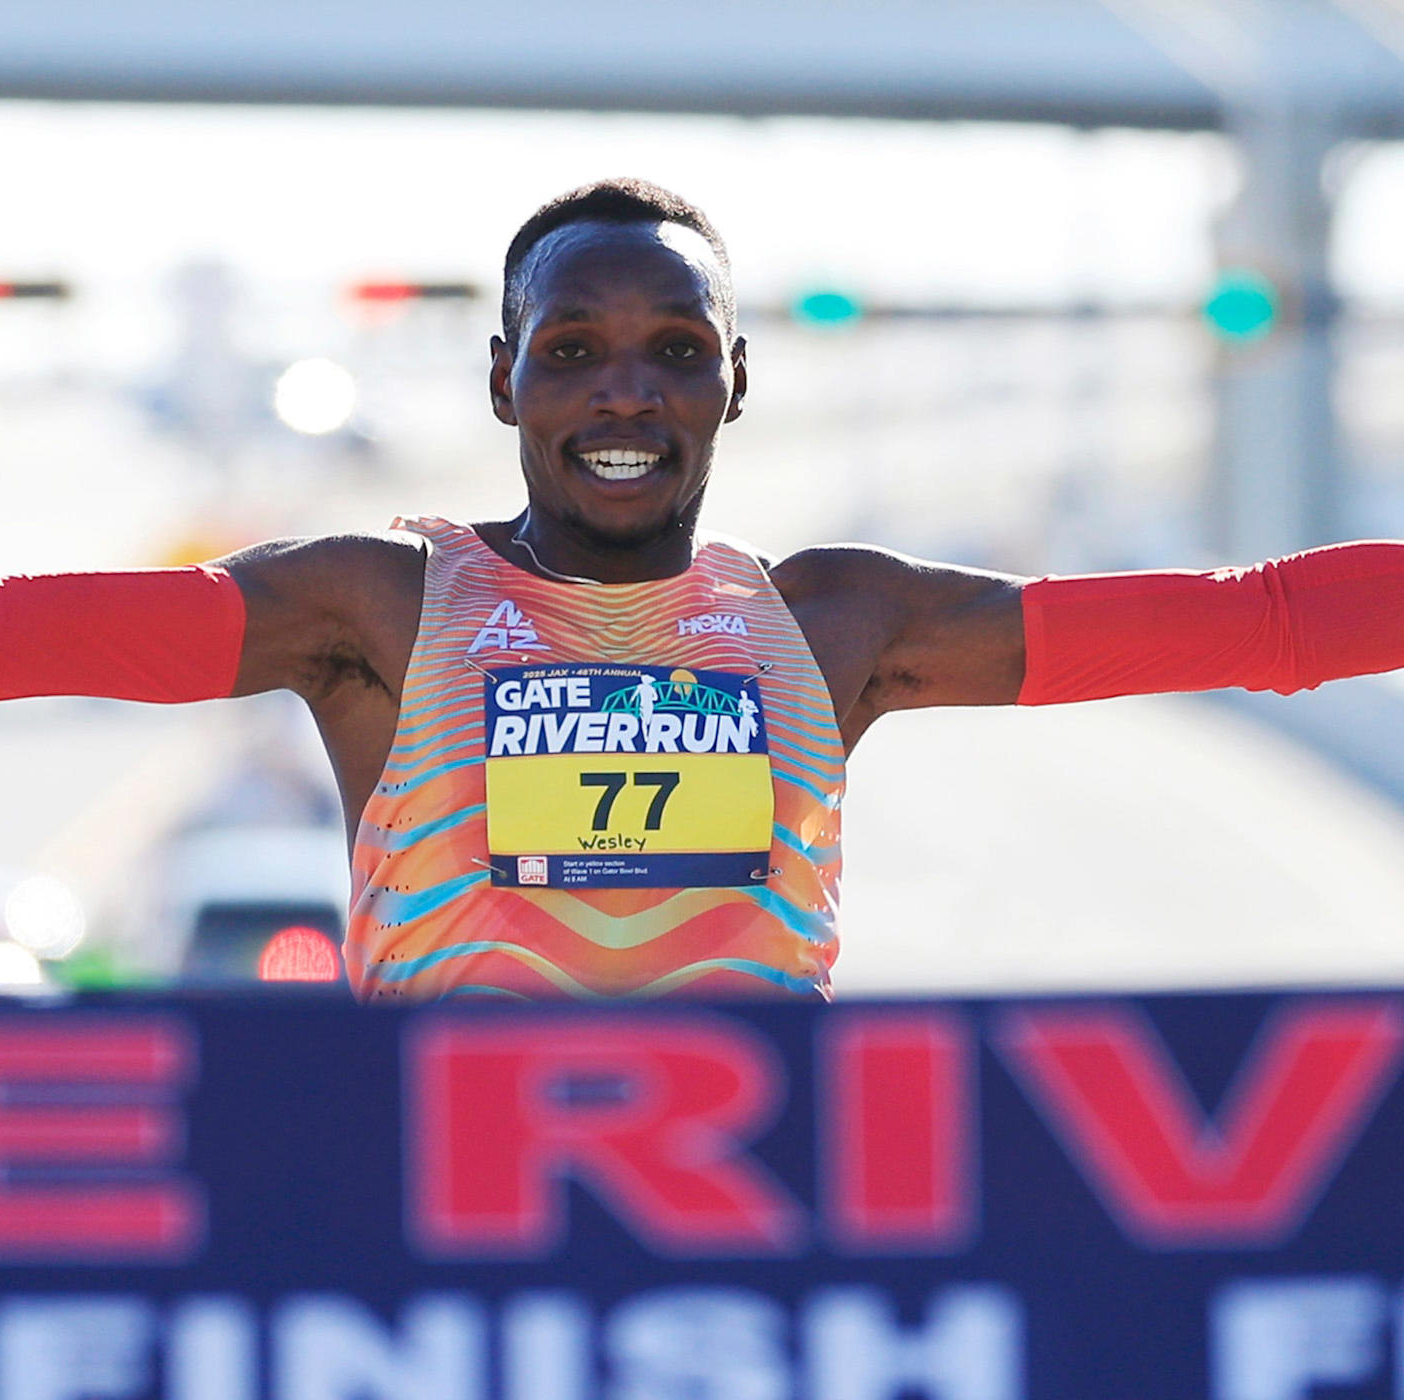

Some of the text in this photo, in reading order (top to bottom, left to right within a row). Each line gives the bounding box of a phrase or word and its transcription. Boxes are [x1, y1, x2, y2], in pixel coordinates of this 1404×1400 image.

[678, 614, 749, 636] HOKA
[547, 668, 568, 677] JAX
[603, 668, 642, 677] ANNUAL
[495, 678, 591, 710] GATE
[490, 712, 747, 756] RIVER RUN
[580, 772, 680, 831] 77
[577, 834, 647, 851] Wesley
